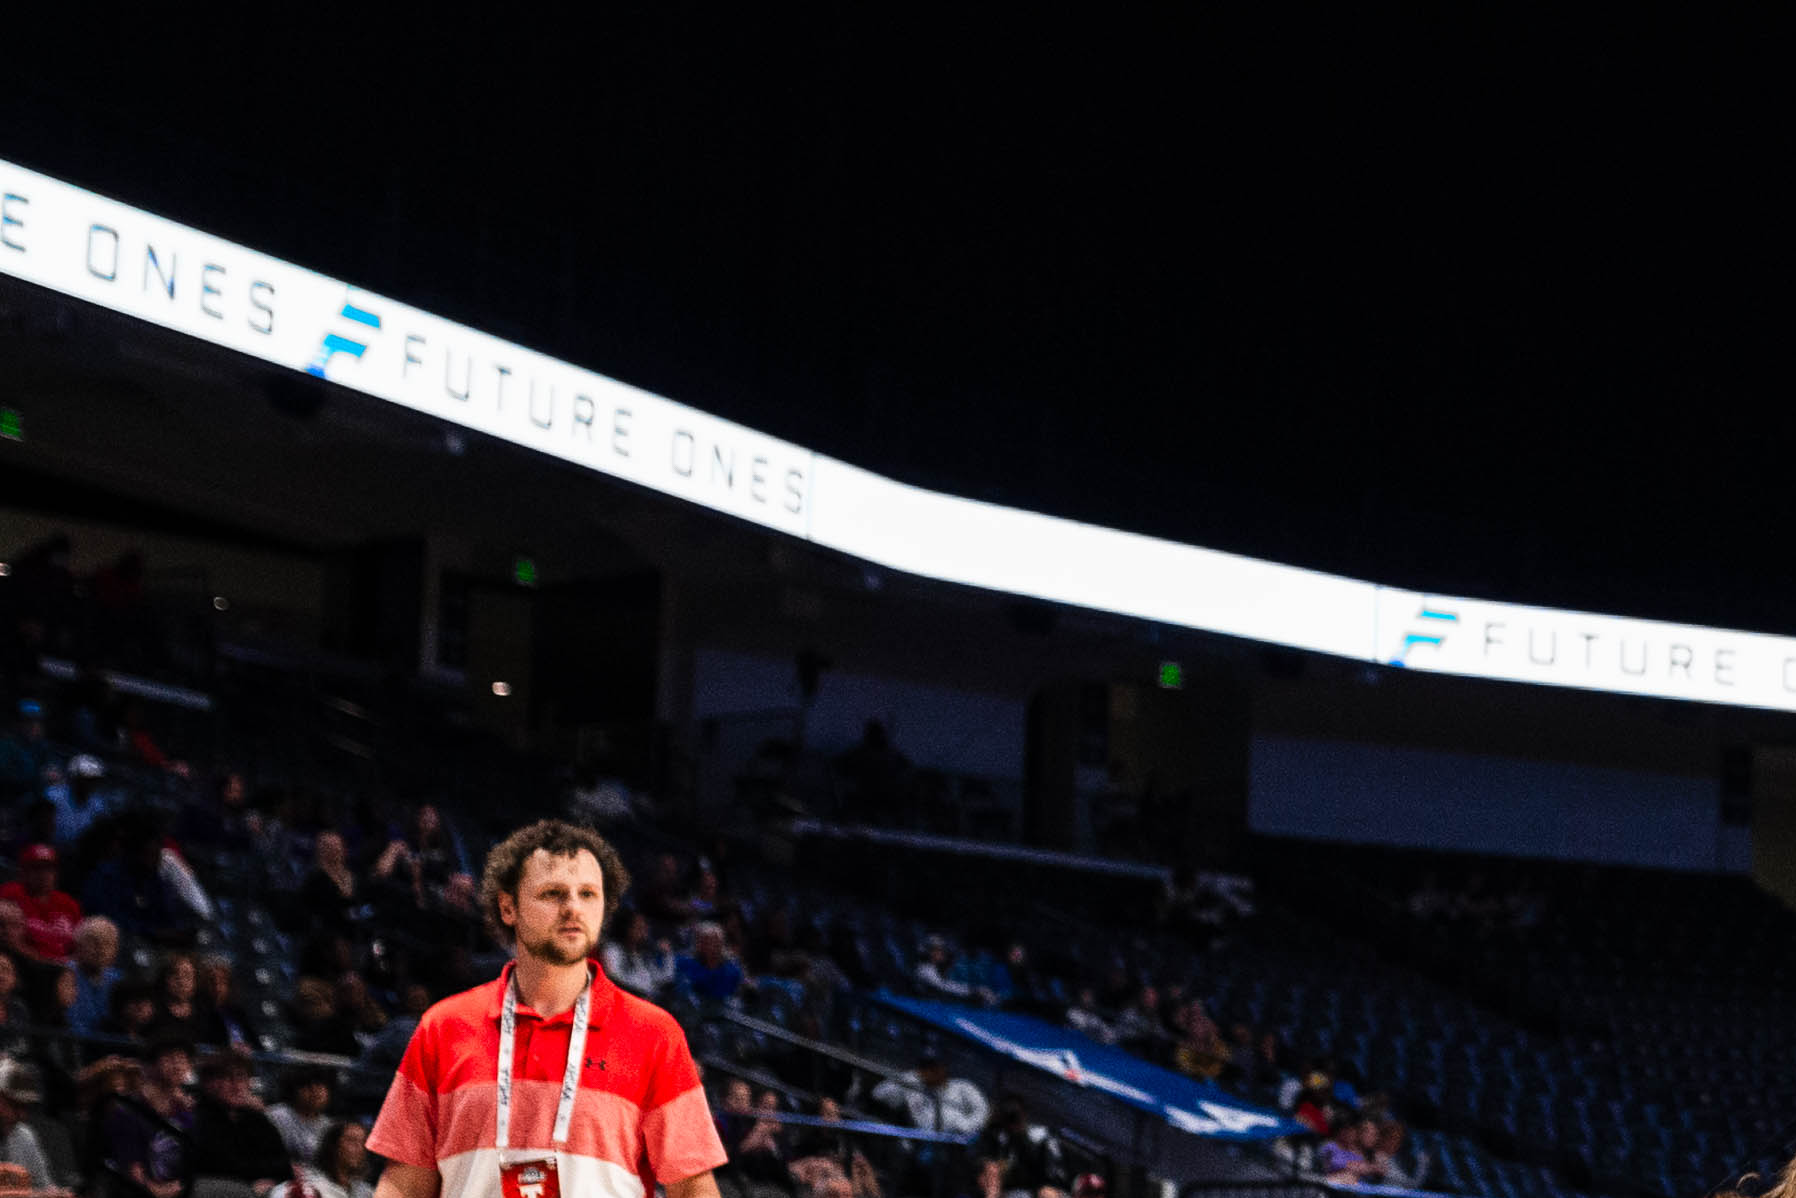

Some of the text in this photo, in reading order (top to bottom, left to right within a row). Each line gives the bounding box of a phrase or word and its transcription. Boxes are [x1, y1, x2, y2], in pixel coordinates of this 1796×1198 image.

[86, 222, 276, 336] ONES
[401, 332, 634, 458] FUTURE
[671, 427, 806, 515] ONES
[1482, 620, 1737, 687] FUTURE
